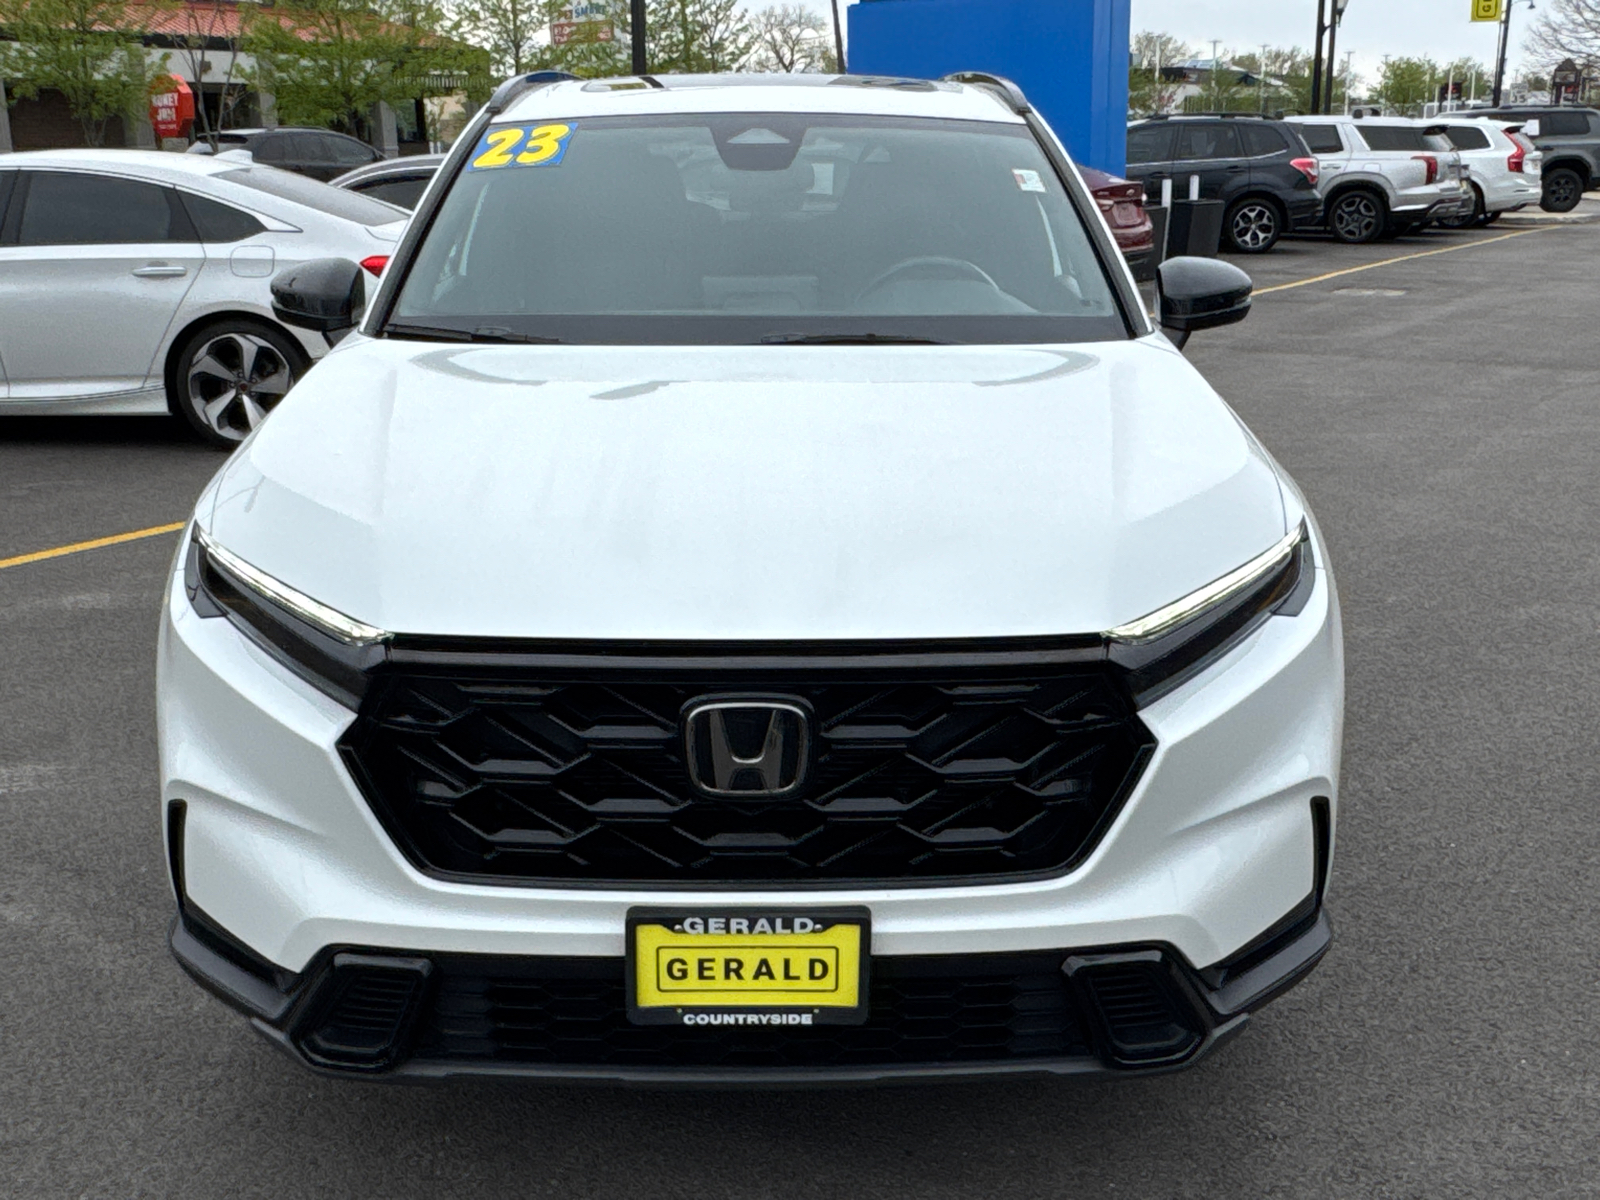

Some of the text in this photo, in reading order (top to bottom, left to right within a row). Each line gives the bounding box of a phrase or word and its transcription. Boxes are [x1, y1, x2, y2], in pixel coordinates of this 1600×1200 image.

[473, 124, 570, 168] 23
[683, 917, 814, 934] GERALD
[666, 957, 829, 981] GERALD
[683, 1013, 813, 1025] COUNTRYSIDE
